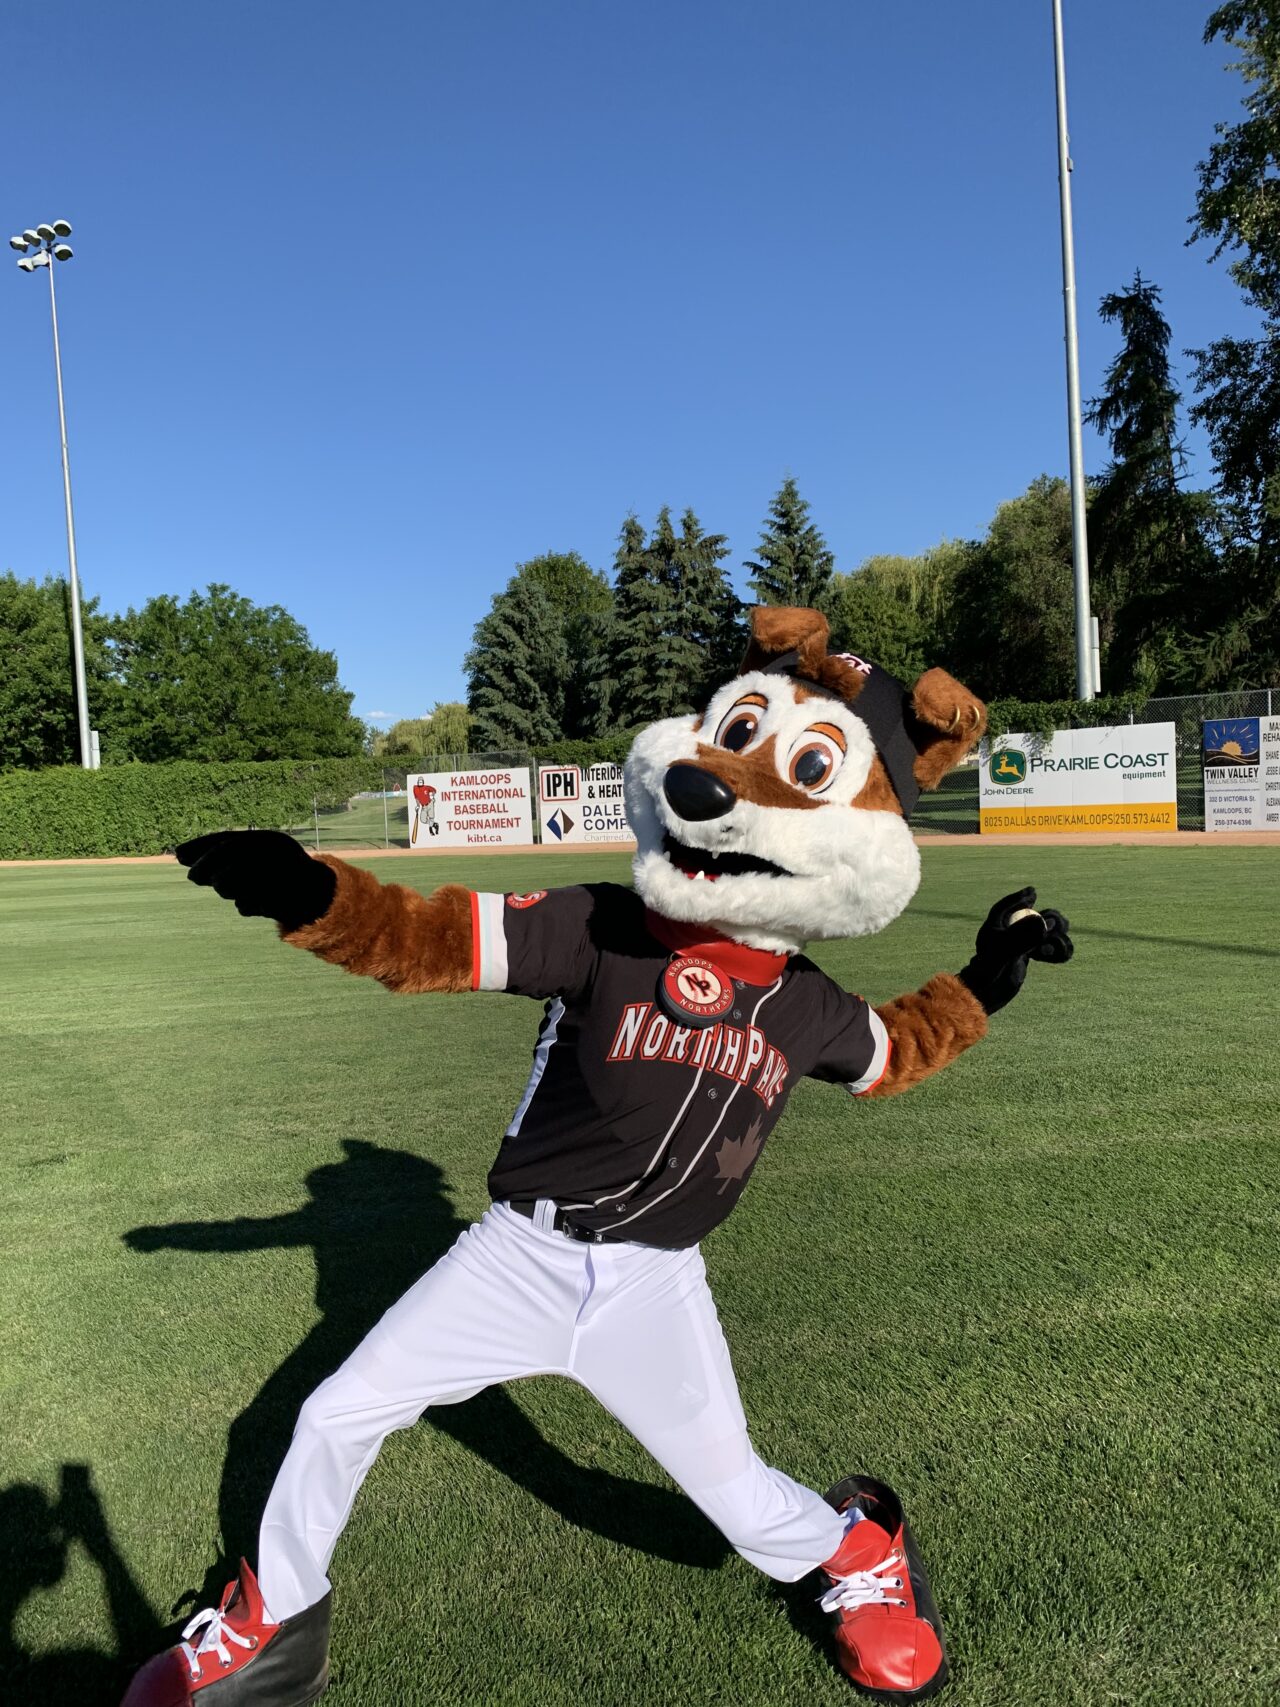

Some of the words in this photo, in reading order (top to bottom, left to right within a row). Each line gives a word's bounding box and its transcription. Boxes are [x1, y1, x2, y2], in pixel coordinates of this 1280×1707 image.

[1031, 756, 1099, 773] PRAIRIE
[1104, 753, 1169, 769] COAST
[581, 766, 622, 782] INTERIOR
[1122, 770, 1166, 780] equipment
[1205, 769, 1226, 779] TWIN
[1228, 767, 1259, 778] VALLEY
[451, 774, 511, 786] KAMLOOPS
[546, 772, 575, 797] IPH
[441, 788, 526, 801] INTERNATIONAL
[587, 785, 595, 799] &
[599, 784, 622, 798] HEAT
[454, 803, 508, 815] BASEBALL
[582, 804, 622, 817] DALE
[447, 817, 521, 831] TOURNAMENT
[984, 816, 1003, 827] 8025
[1004, 816, 1037, 826] DALLAS
[467, 834, 502, 843] kibt.ca
[668, 958, 713, 977] KAMLOOPS
[680, 988, 731, 1013] NORTHPAWS
